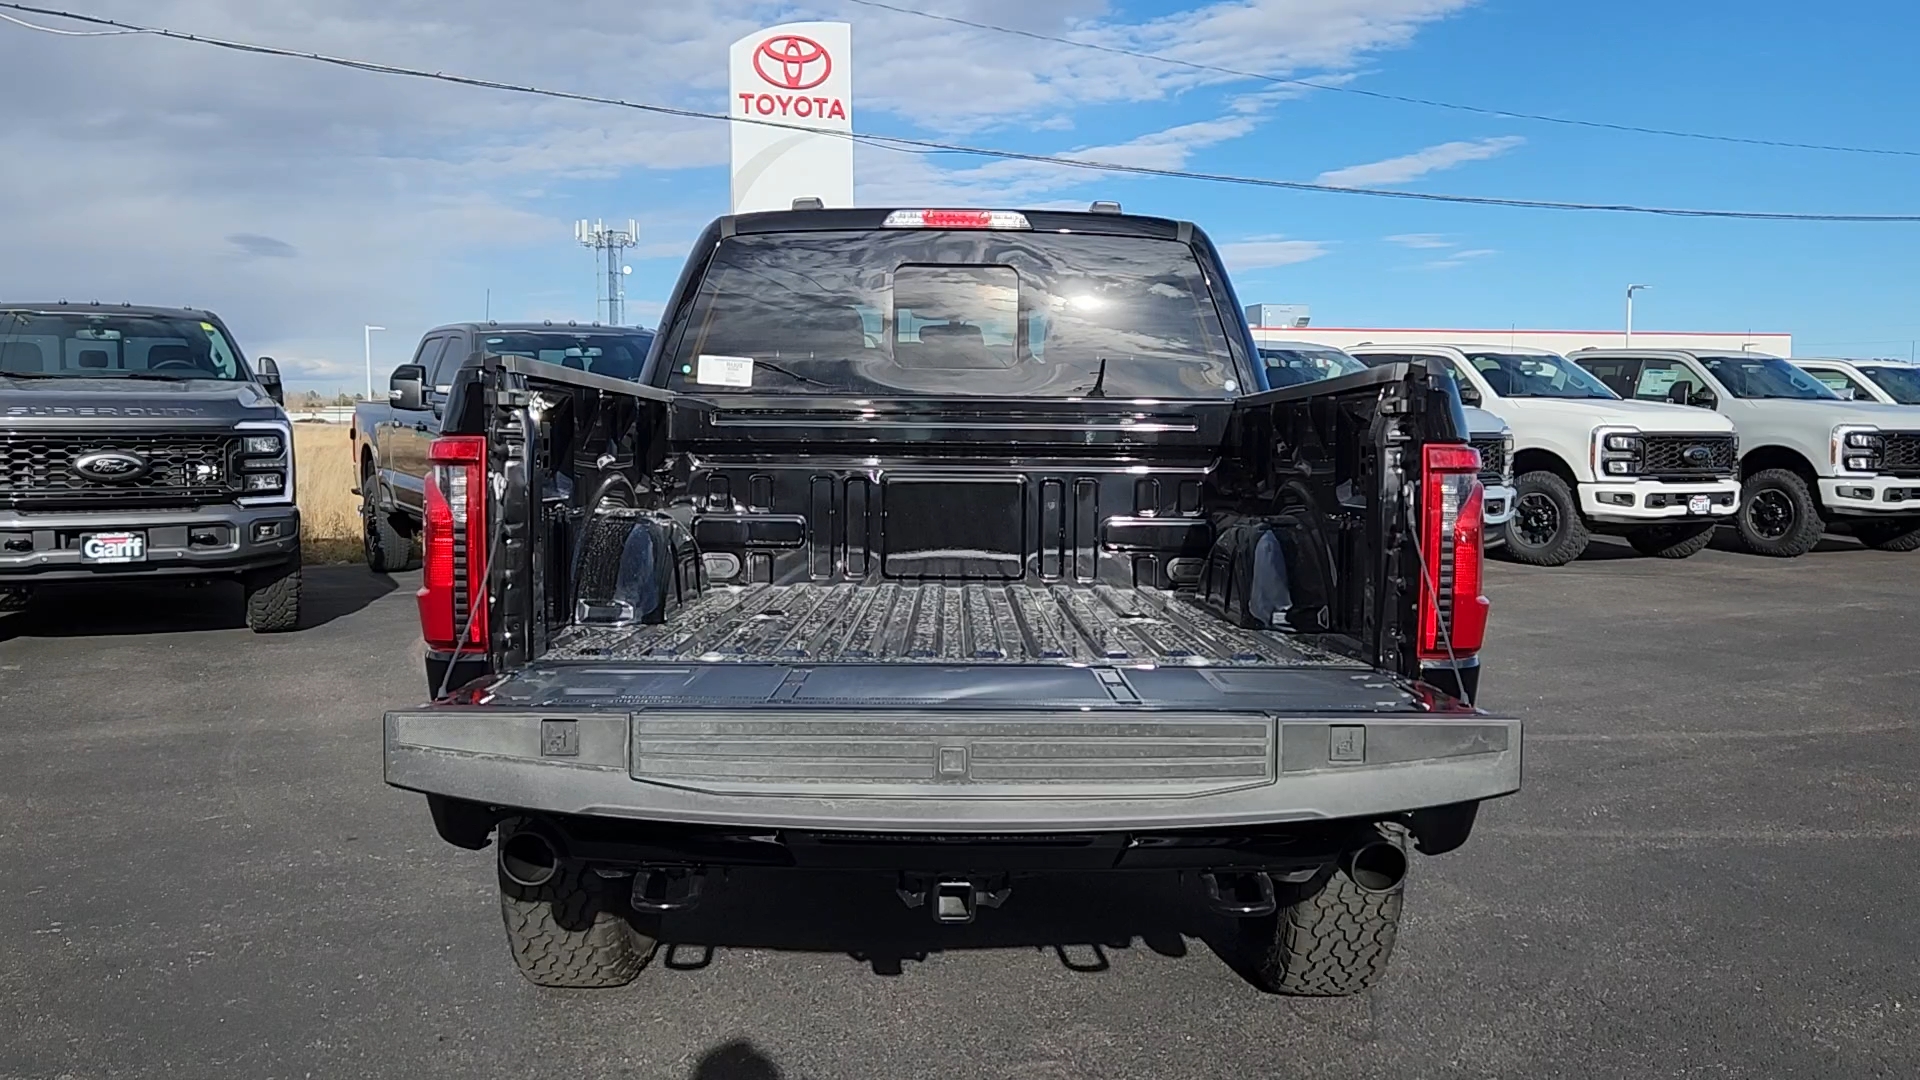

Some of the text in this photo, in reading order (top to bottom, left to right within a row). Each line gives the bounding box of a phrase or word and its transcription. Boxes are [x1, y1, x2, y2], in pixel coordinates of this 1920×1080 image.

[739, 93, 846, 120] TOYOTA
[6, 406, 204, 416] SUPER DUTY
[93, 459, 128, 472] Ford
[85, 538, 142, 558] Garff
